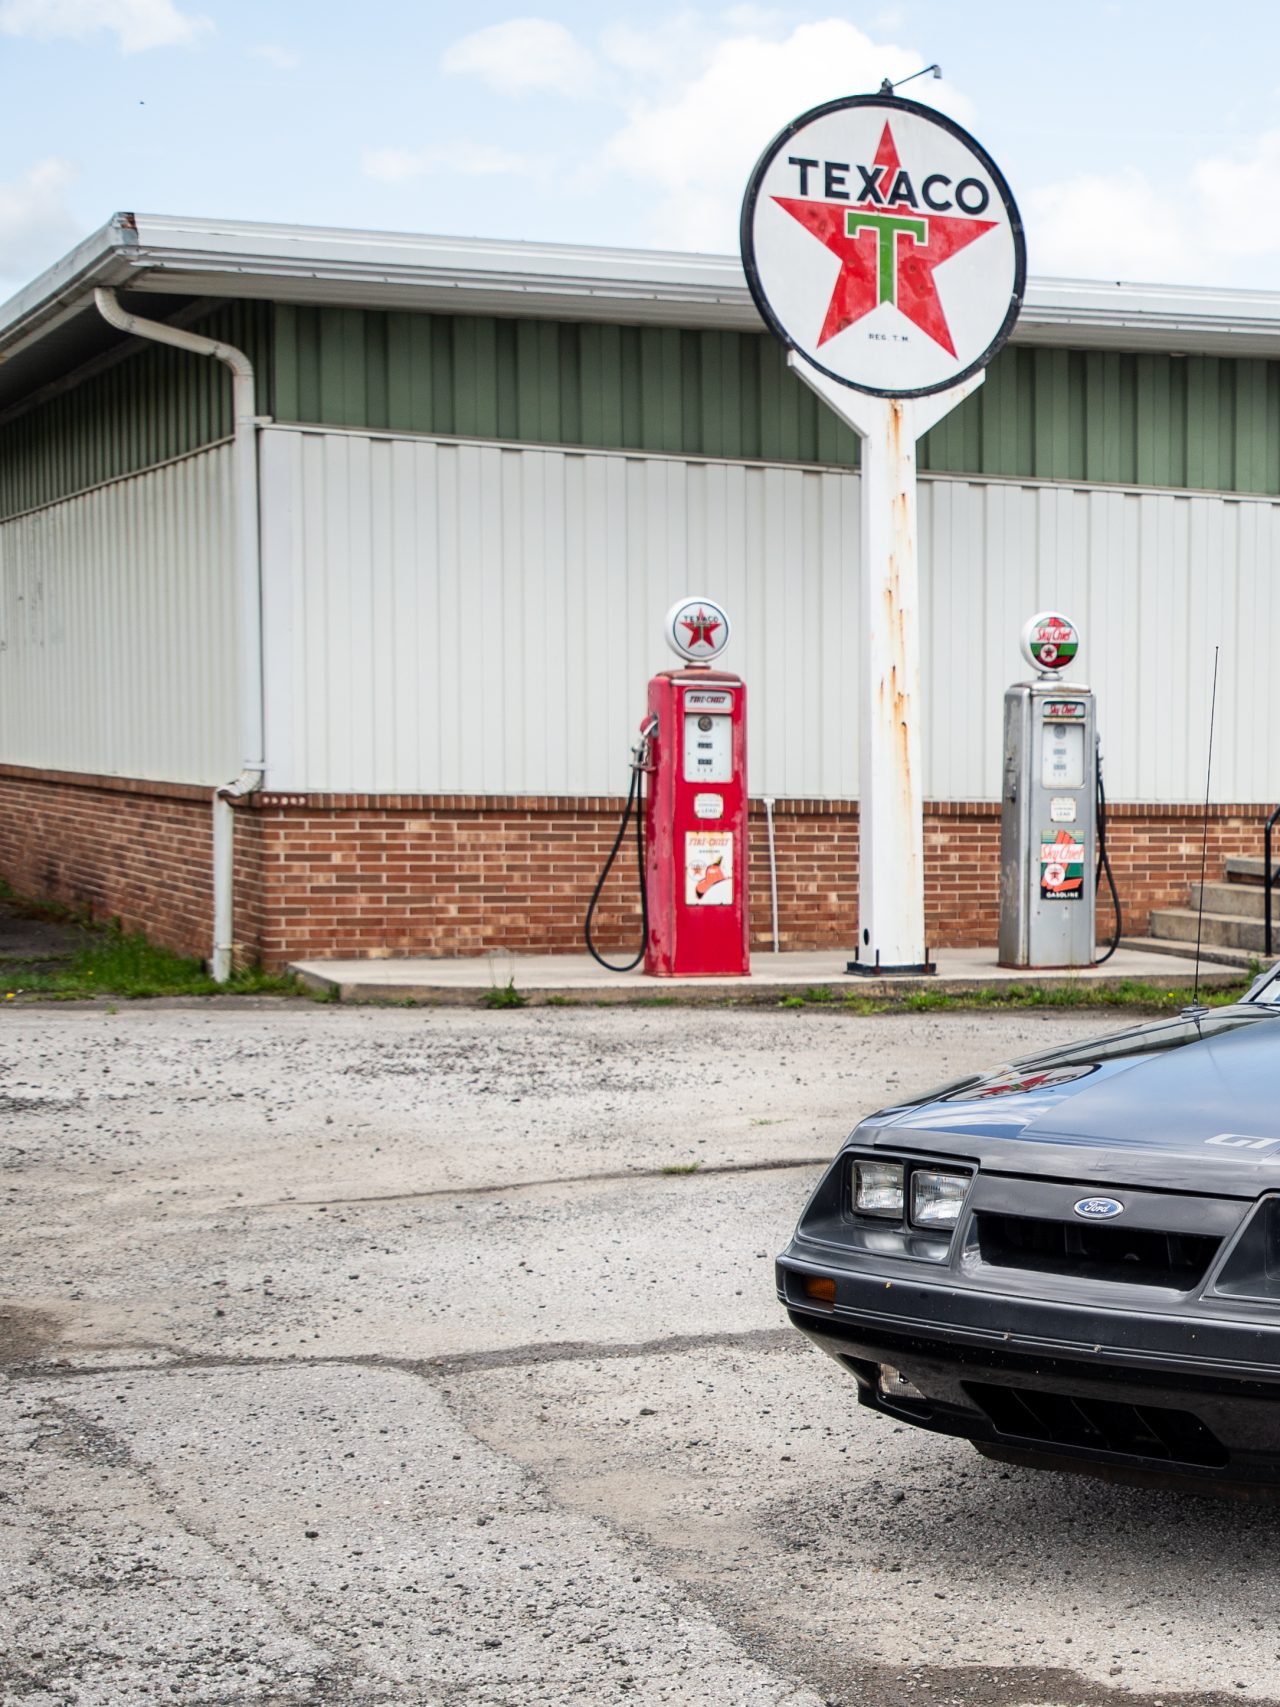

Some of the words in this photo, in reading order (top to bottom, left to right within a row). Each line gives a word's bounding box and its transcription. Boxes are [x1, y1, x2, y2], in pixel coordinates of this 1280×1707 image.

[789, 156, 990, 215] TEXACO
[847, 211, 926, 306] T
[684, 615, 719, 623] TEXACO
[1037, 627, 1051, 643] Sky
[1053, 628, 1072, 641] Chief
[1051, 703, 1060, 715] Sky
[1041, 845, 1058, 862] Sky
[1060, 845, 1084, 860] Chief
[1046, 891, 1079, 899] GASOLINE
[1084, 1200, 1112, 1213] Ford
